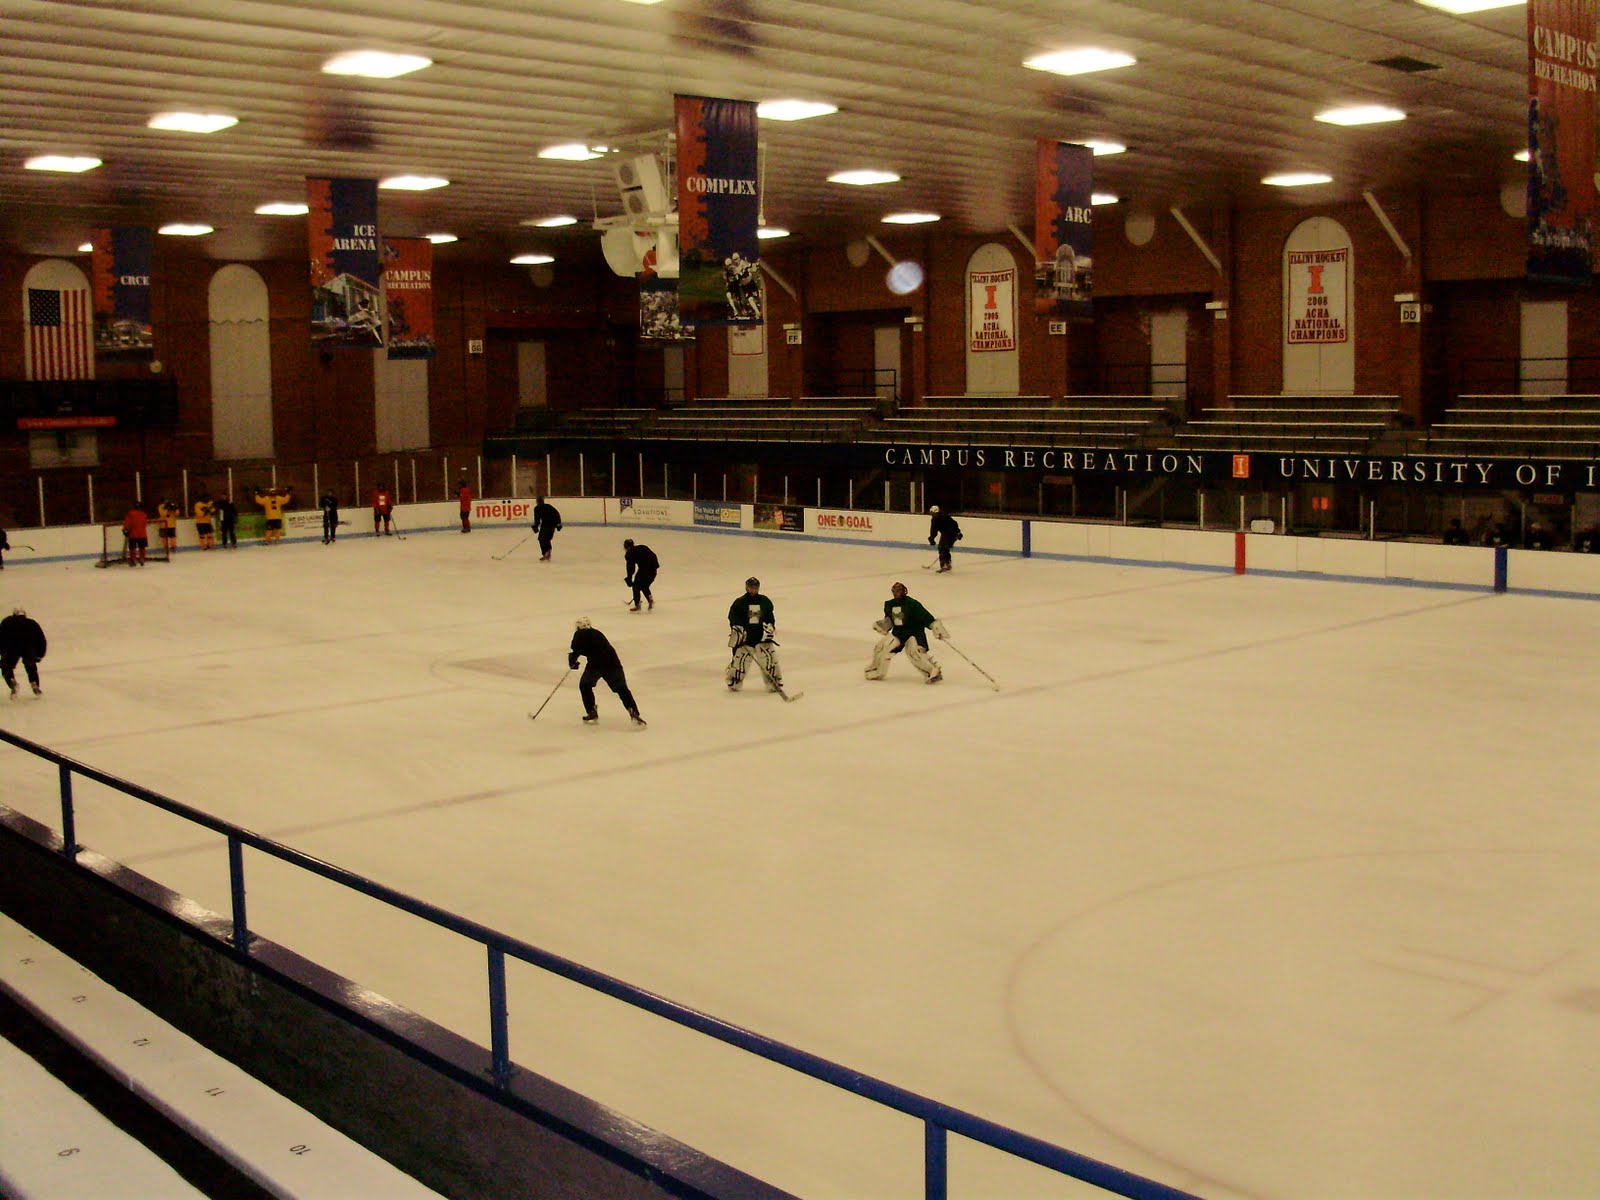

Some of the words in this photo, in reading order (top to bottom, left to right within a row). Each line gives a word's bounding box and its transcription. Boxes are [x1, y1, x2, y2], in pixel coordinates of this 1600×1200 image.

[1533, 26, 1597, 69] CAMPUS
[1534, 58, 1597, 91] RECREATION
[686, 176, 757, 196] COMPLEX
[1064, 206, 1092, 224] ARC
[353, 224, 375, 238] ICE
[332, 238, 377, 251] ARENA
[1290, 255, 1313, 264] ILLINI
[1316, 252, 1345, 263] HOCKEY
[120, 275, 150, 287] CRCE
[386, 270, 431, 282] CAMPUS
[1307, 265, 1324, 294] I
[387, 281, 432, 290] RECREATION
[984, 285, 997, 310] I
[1307, 296, 1328, 306] 2008
[1306, 308, 1330, 318] ACHA
[1403, 311, 1416, 320] DD
[1051, 325, 1062, 333] EE
[1295, 319, 1341, 329] NATIONAL
[1291, 329, 1345, 340] CHAMPIONS
[973, 339, 1012, 349] CHAMPIONS
[885, 447, 985, 468] CAMPUS
[1005, 450, 1205, 475] RECREATION
[1280, 456, 1494, 485] UNIVERSITY
[1515, 463, 1562, 486] OF
[476, 500, 529, 520] meijer
[818, 514, 837, 527] ONE
[846, 515, 873, 529] GOAL
[290, 1144, 311, 1156] 10
